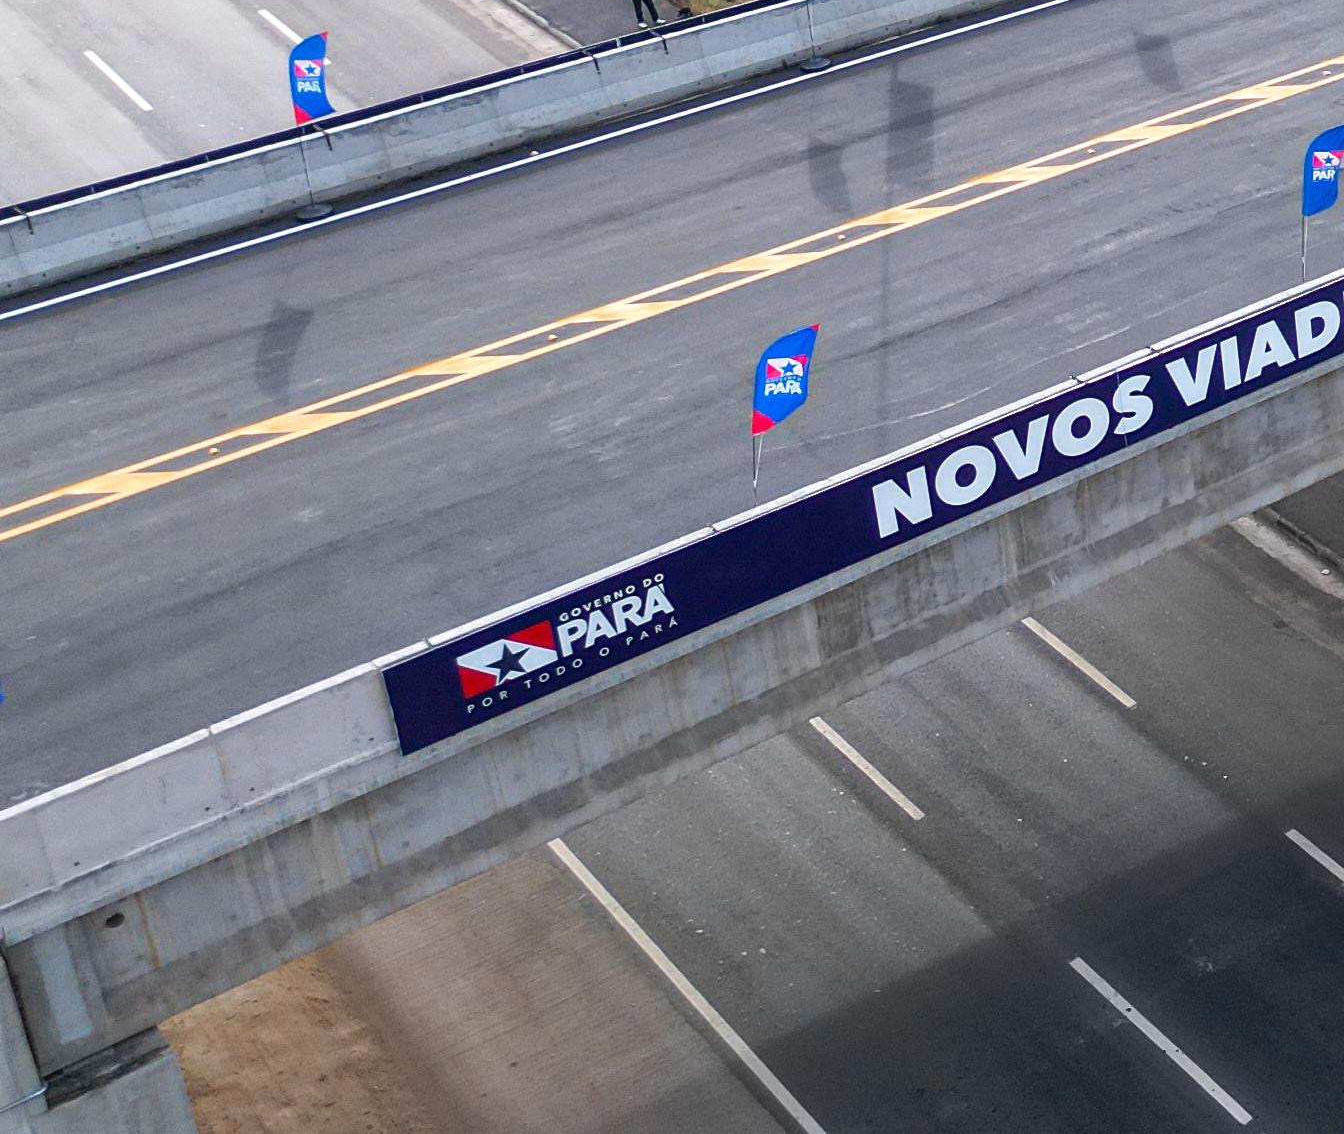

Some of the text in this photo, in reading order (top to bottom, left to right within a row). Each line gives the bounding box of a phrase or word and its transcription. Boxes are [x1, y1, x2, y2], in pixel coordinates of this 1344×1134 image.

[1313, 168, 1336, 182] PAR
[870, 372, 1154, 540] NOVOS
[556, 582, 675, 658] PARÁ
[559, 572, 665, 622] GOVERNO DO
[466, 616, 679, 715] POR TODO O PARÁ
